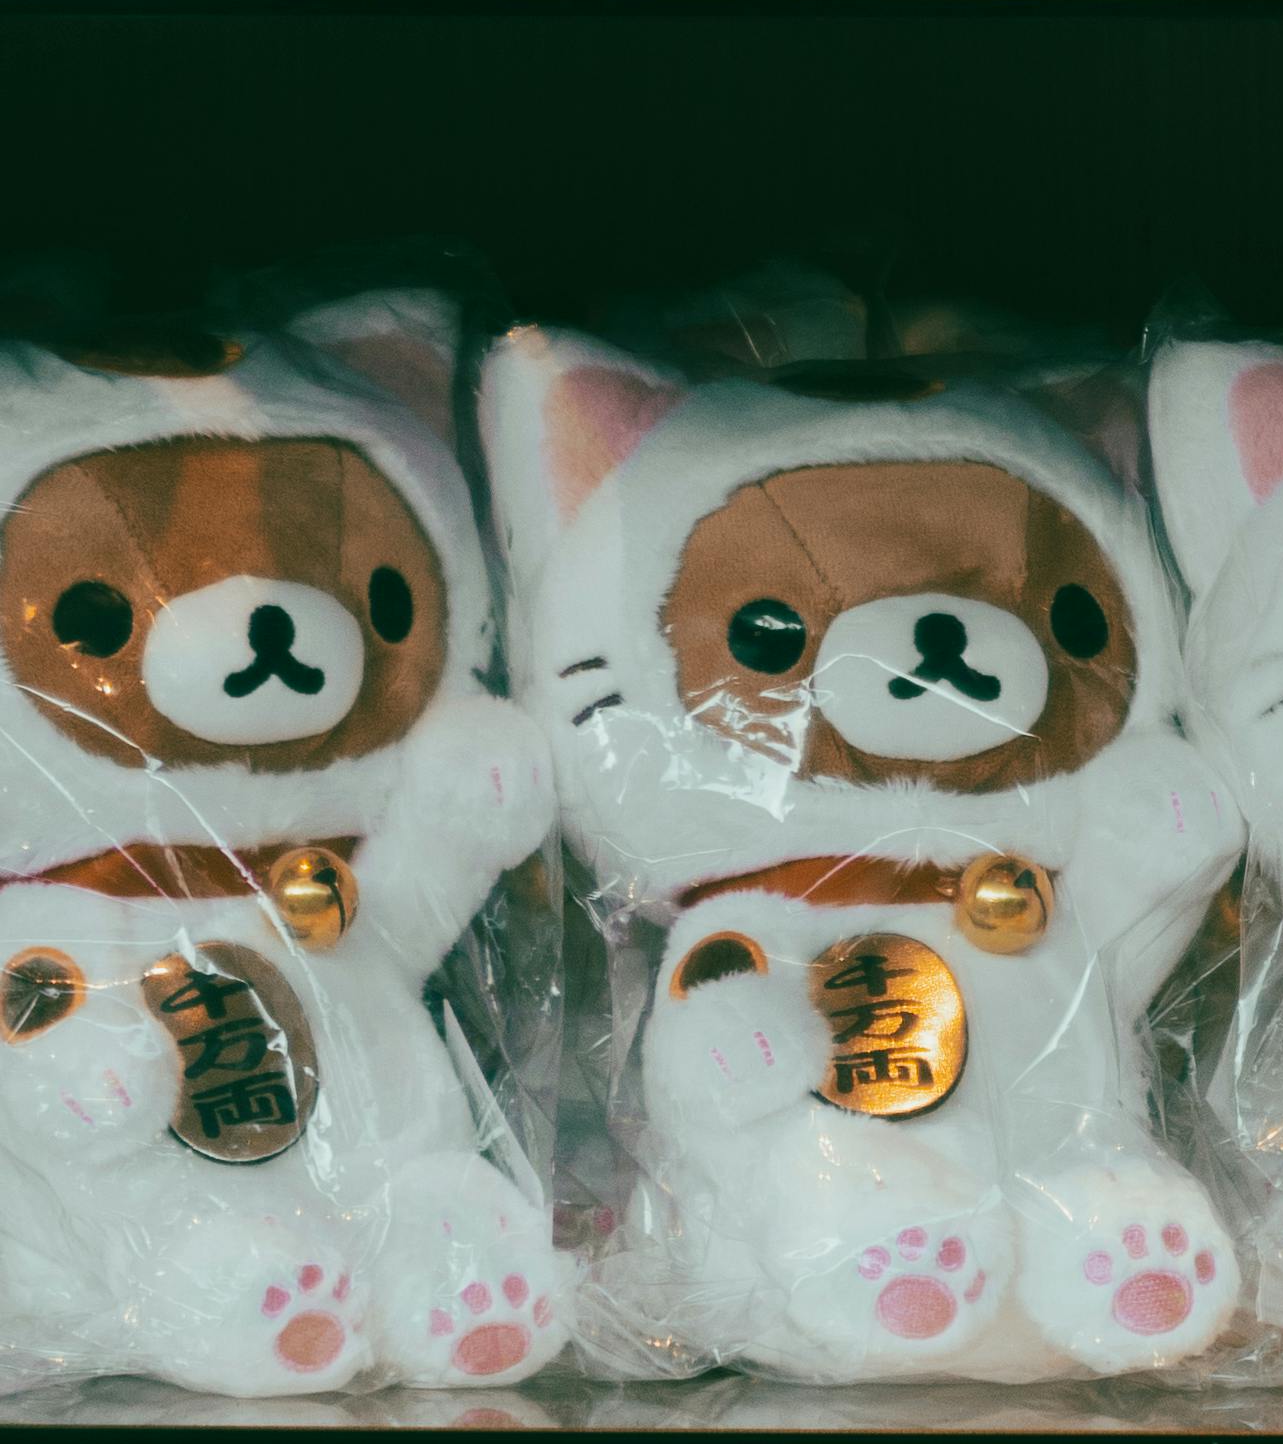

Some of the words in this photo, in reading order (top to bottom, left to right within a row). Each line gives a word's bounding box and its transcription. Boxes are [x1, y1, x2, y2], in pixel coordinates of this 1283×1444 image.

[159, 969, 299, 1139] 千万両
[823, 954, 934, 1094] 千万両
